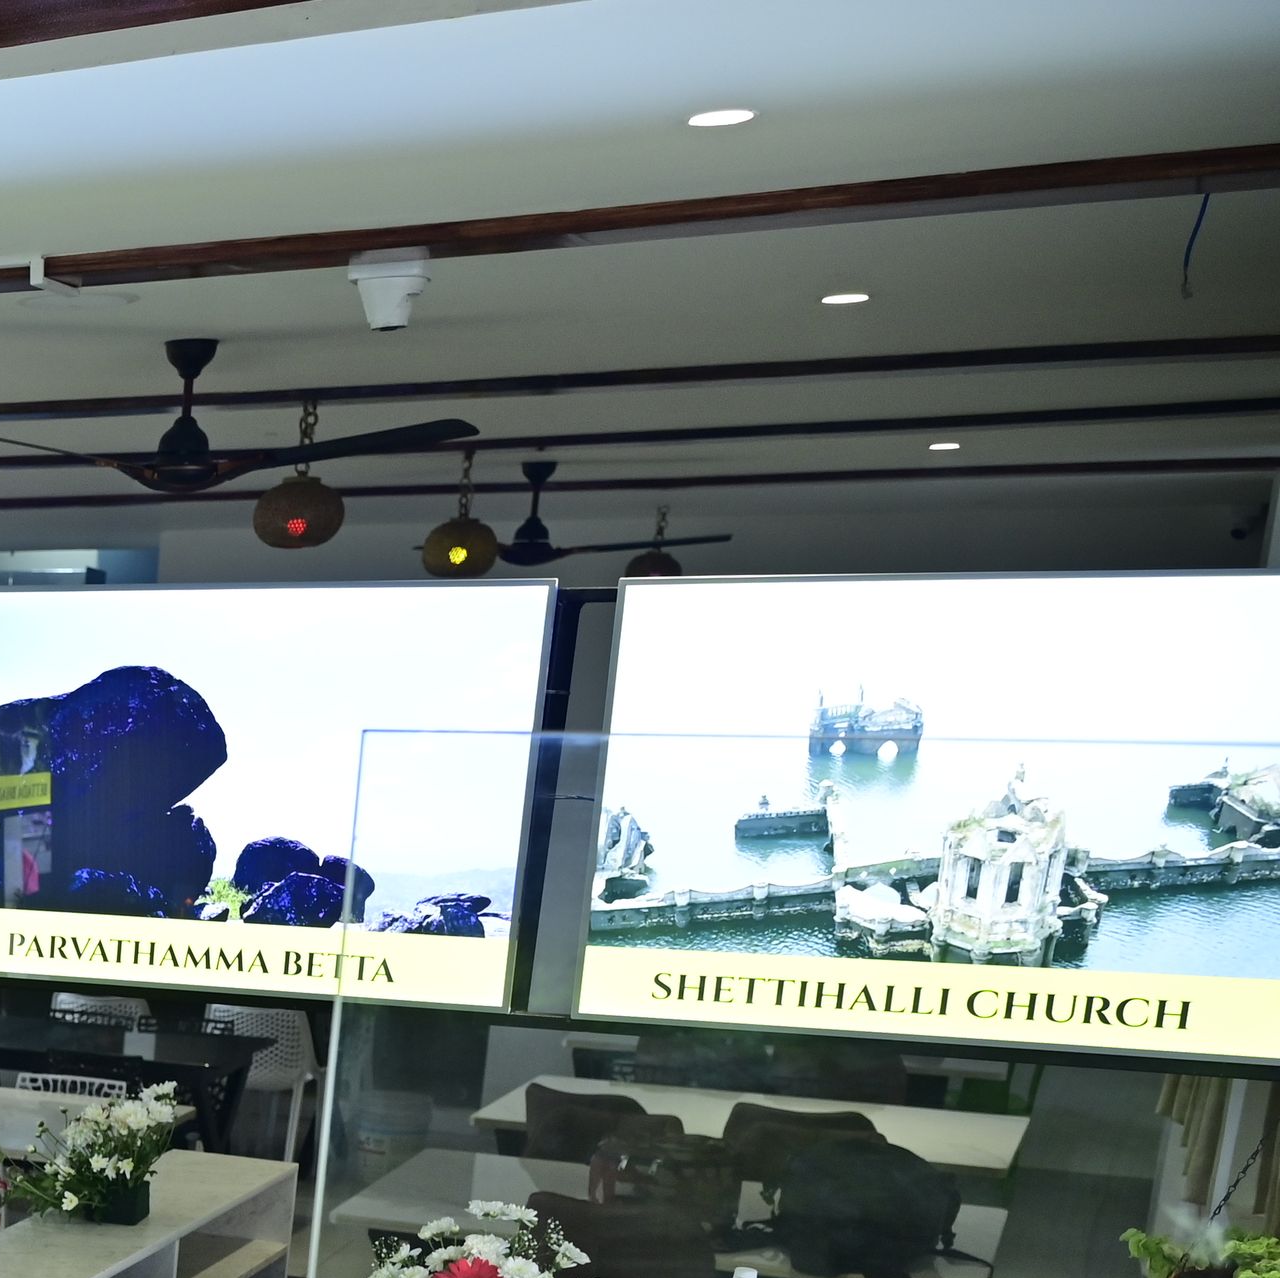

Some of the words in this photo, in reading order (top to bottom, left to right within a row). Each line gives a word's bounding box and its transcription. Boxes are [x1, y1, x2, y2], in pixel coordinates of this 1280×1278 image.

[7, 932, 269, 974] PARVATHAMMA
[282, 950, 395, 984] BETTA
[650, 971, 951, 1016] SHETTIHALLI
[966, 988, 1193, 1030] CHURCH
